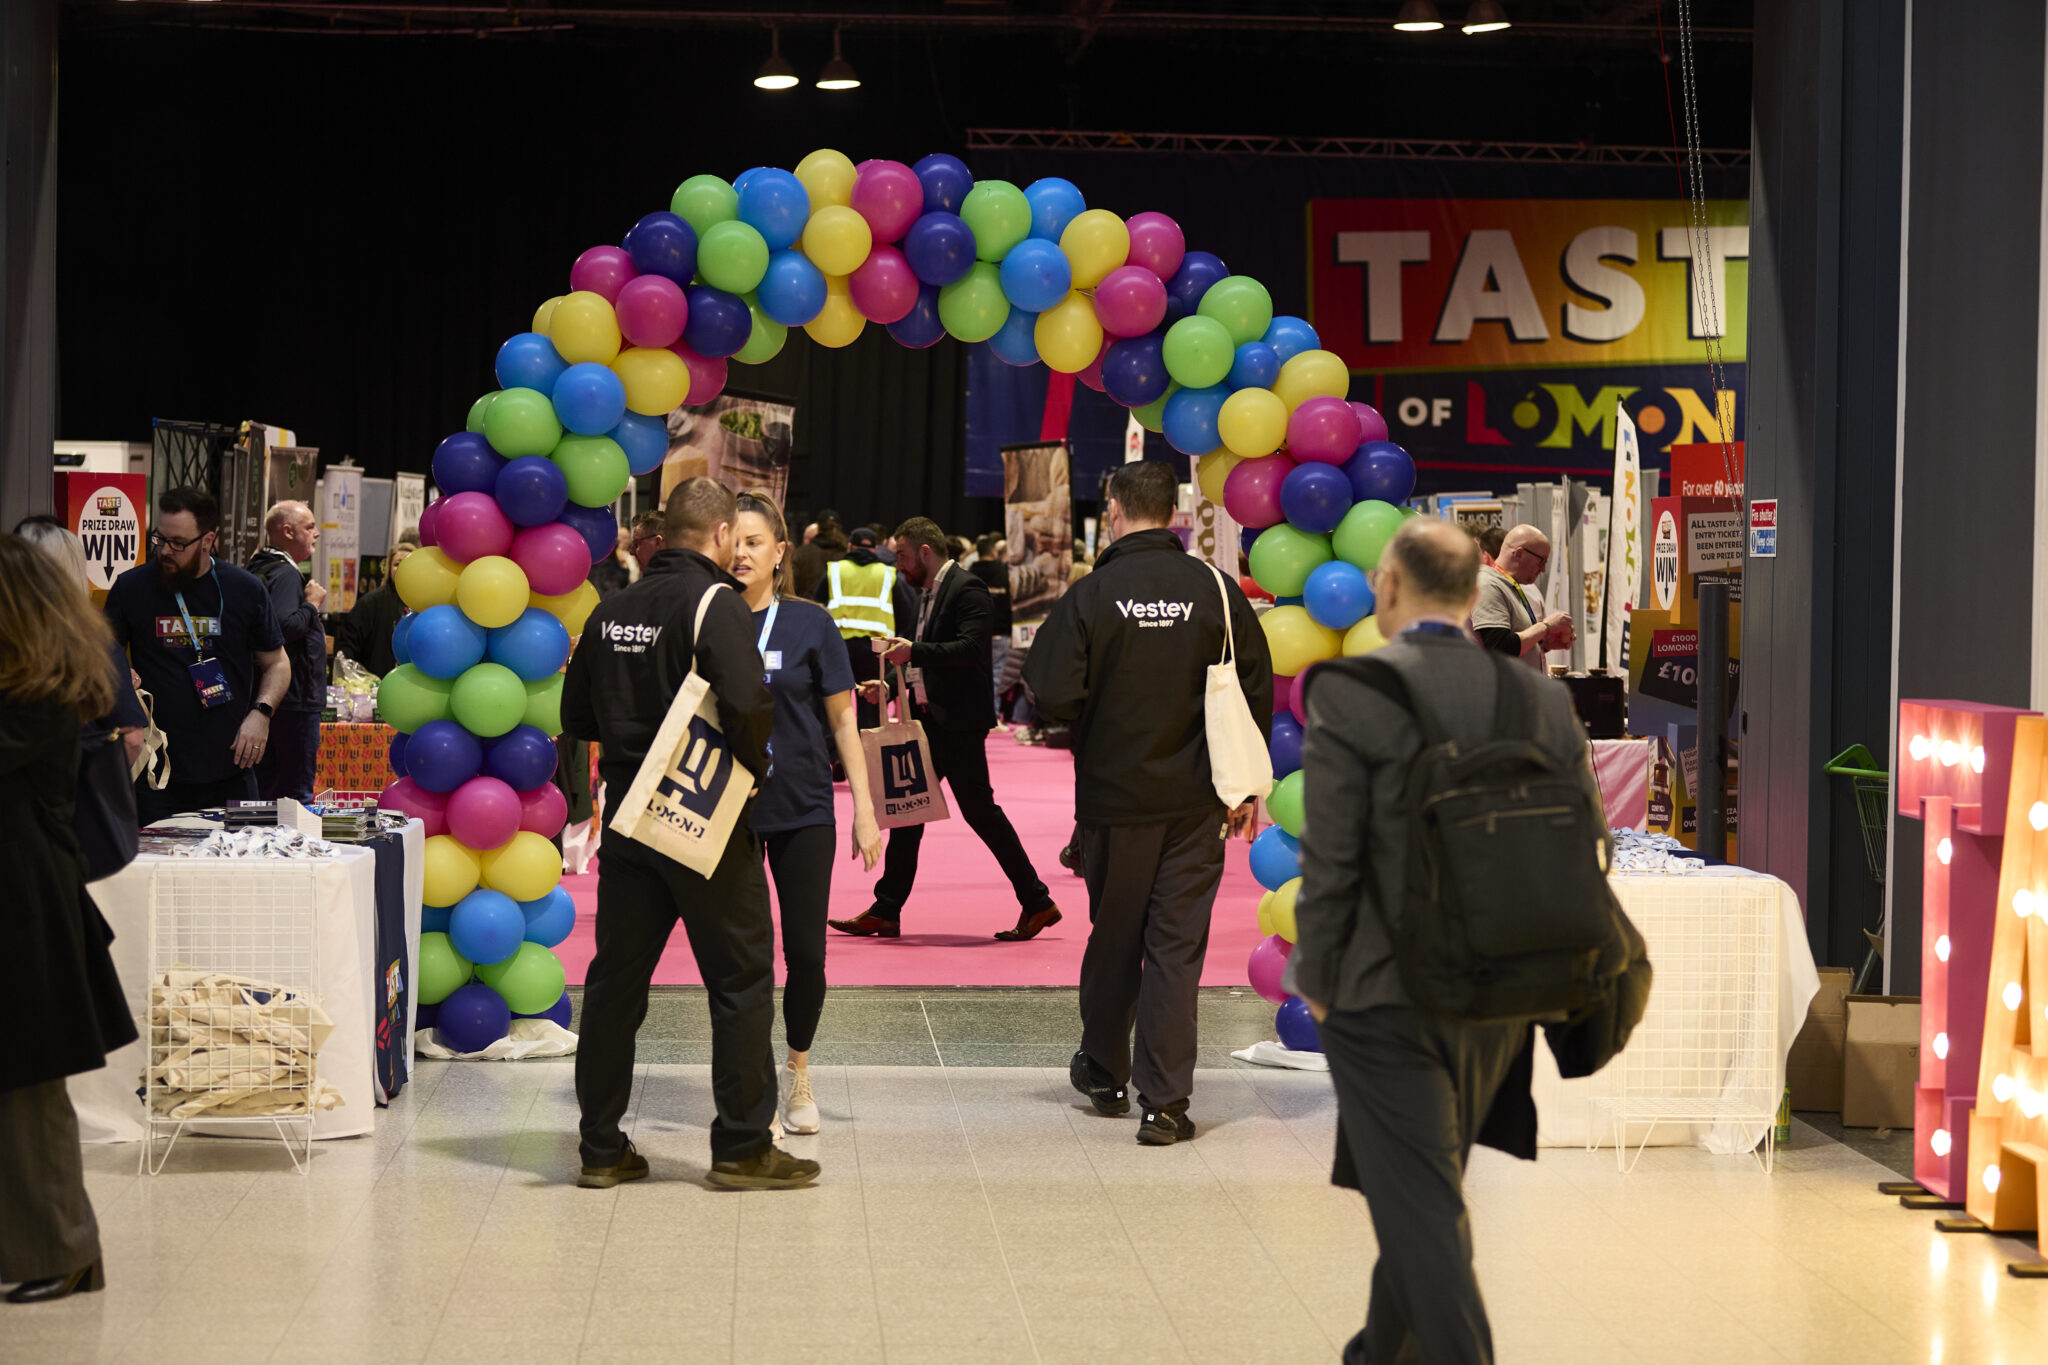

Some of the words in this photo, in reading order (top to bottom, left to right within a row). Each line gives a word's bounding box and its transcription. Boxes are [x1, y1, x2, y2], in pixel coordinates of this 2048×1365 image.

[1398, 397, 1452, 427] OF
[1682, 480, 1695, 496] For
[1696, 483, 1713, 496] over
[1714, 480, 1724, 495] 60
[97, 497, 121, 510] TASTE
[82, 519, 107, 531] PRIZE
[108, 519, 136, 531] DRAW
[1691, 520, 1706, 529] ALL
[1707, 520, 1727, 528] TASTE
[1695, 531, 1716, 539] ENTRY
[82, 534, 136, 561] WIN!
[1696, 542, 1714, 550] BEEN
[1701, 552, 1715, 560] OUR
[1717, 552, 1734, 560] PRIZE
[1656, 556, 1677, 583] WIN!
[1115, 598, 1194, 621] Vestey
[159, 618, 219, 634] TATE
[1138, 620, 1158, 628] Since
[1158, 619, 1174, 627] 1897
[601, 620, 663, 647] Vestey
[1671, 634, 1697, 643] £1000
[613, 643, 631, 652] Since
[1657, 643, 1694, 653] LOMOND
[1657, 661, 1698, 686] £10
